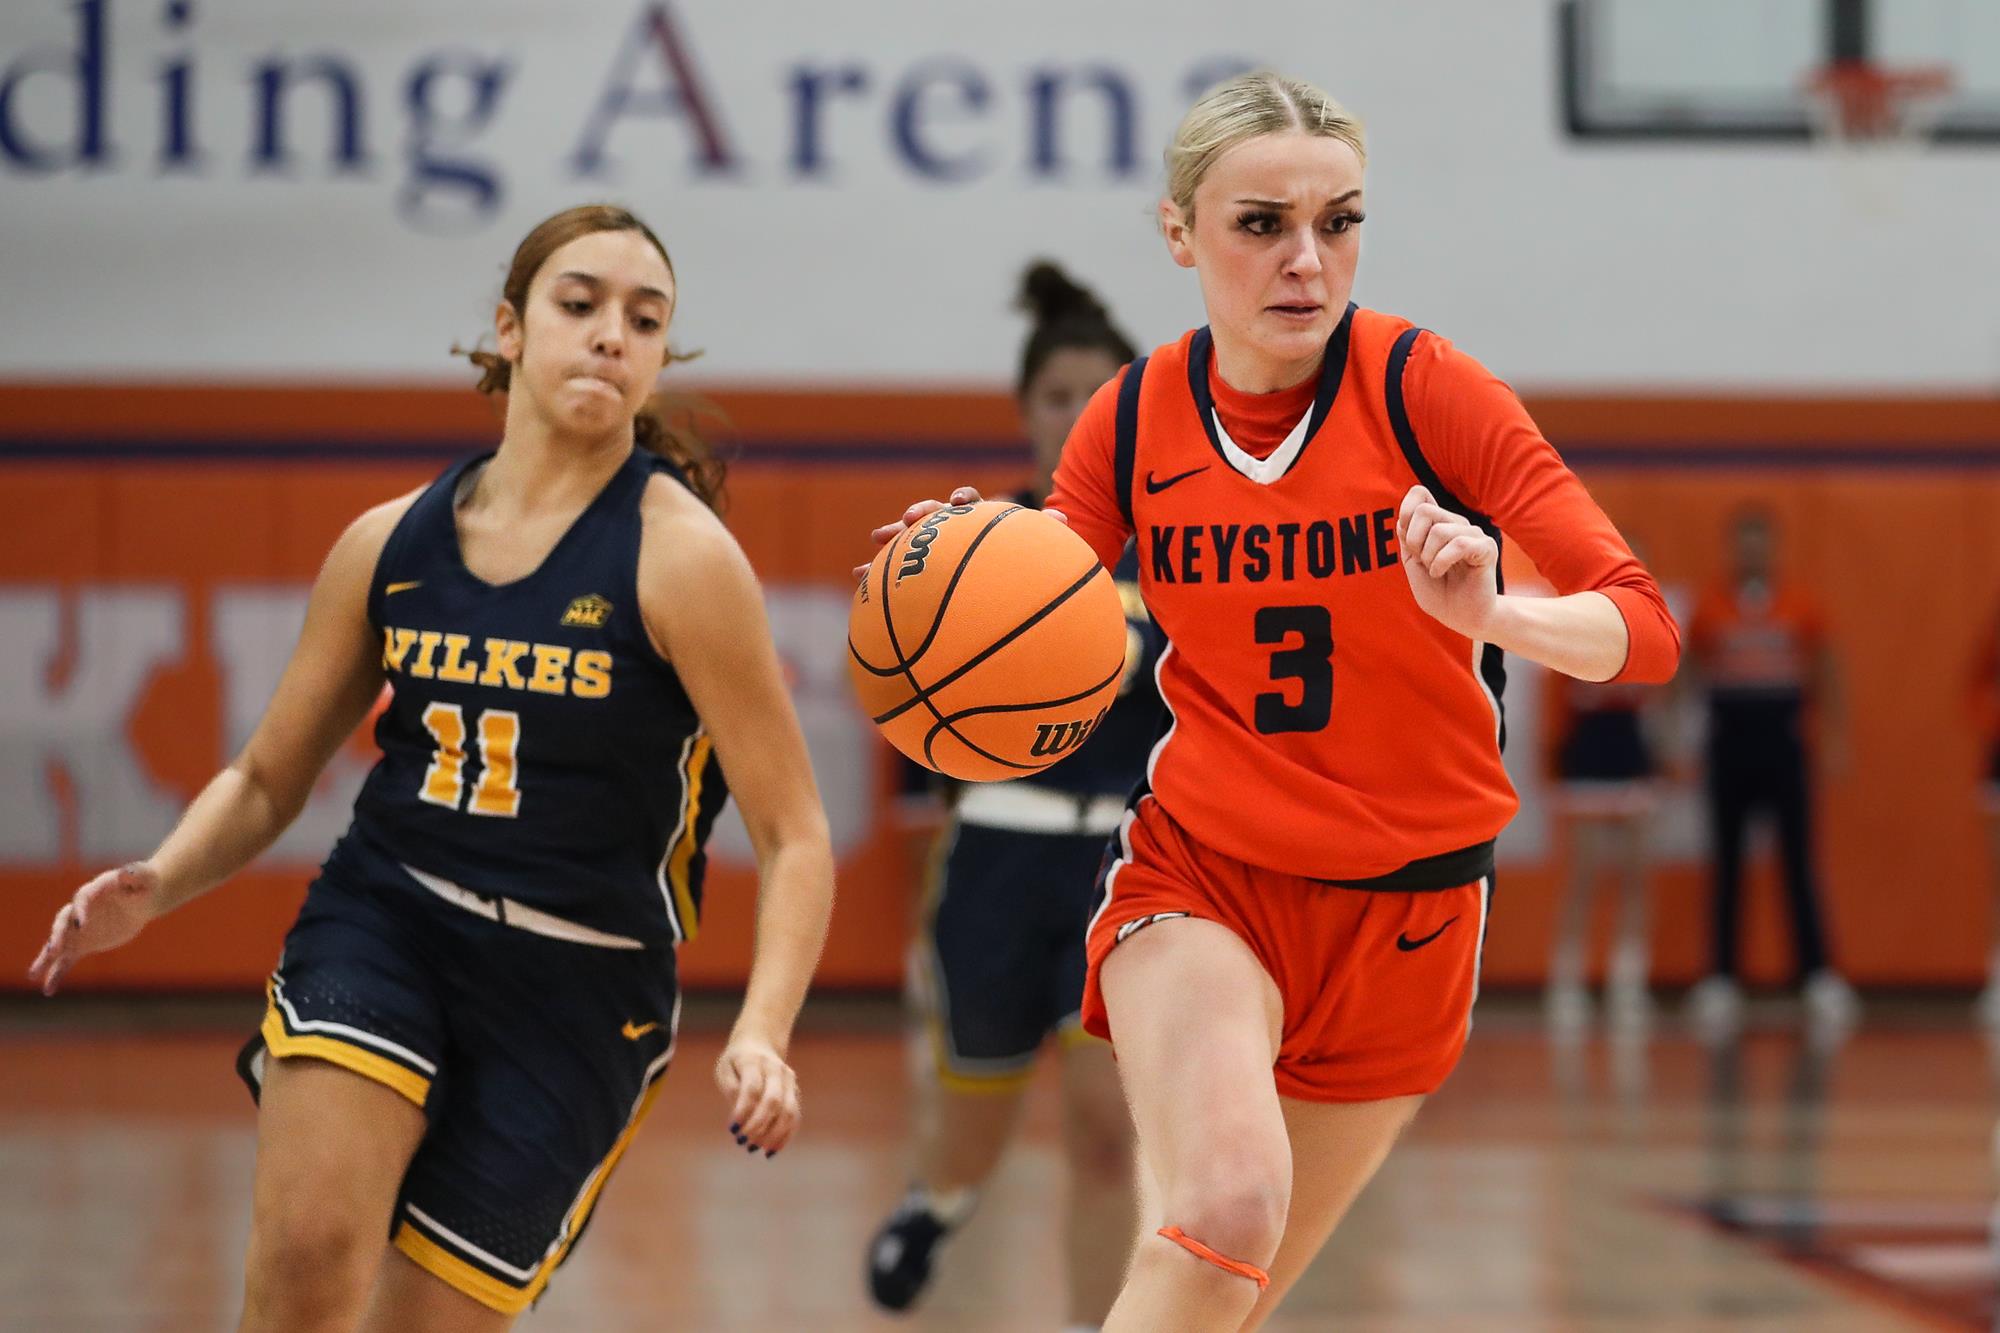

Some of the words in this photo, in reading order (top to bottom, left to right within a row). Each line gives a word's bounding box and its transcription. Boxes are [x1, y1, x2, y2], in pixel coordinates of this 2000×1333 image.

[0, 0, 515, 234] ding
[562, 0, 1262, 186] Aren
[1151, 507, 1399, 584] KEYSTONE
[382, 626, 614, 698] WILKES
[1254, 605, 1335, 735] 3
[418, 701, 522, 817] 11
[1029, 705, 1108, 757] Wil
